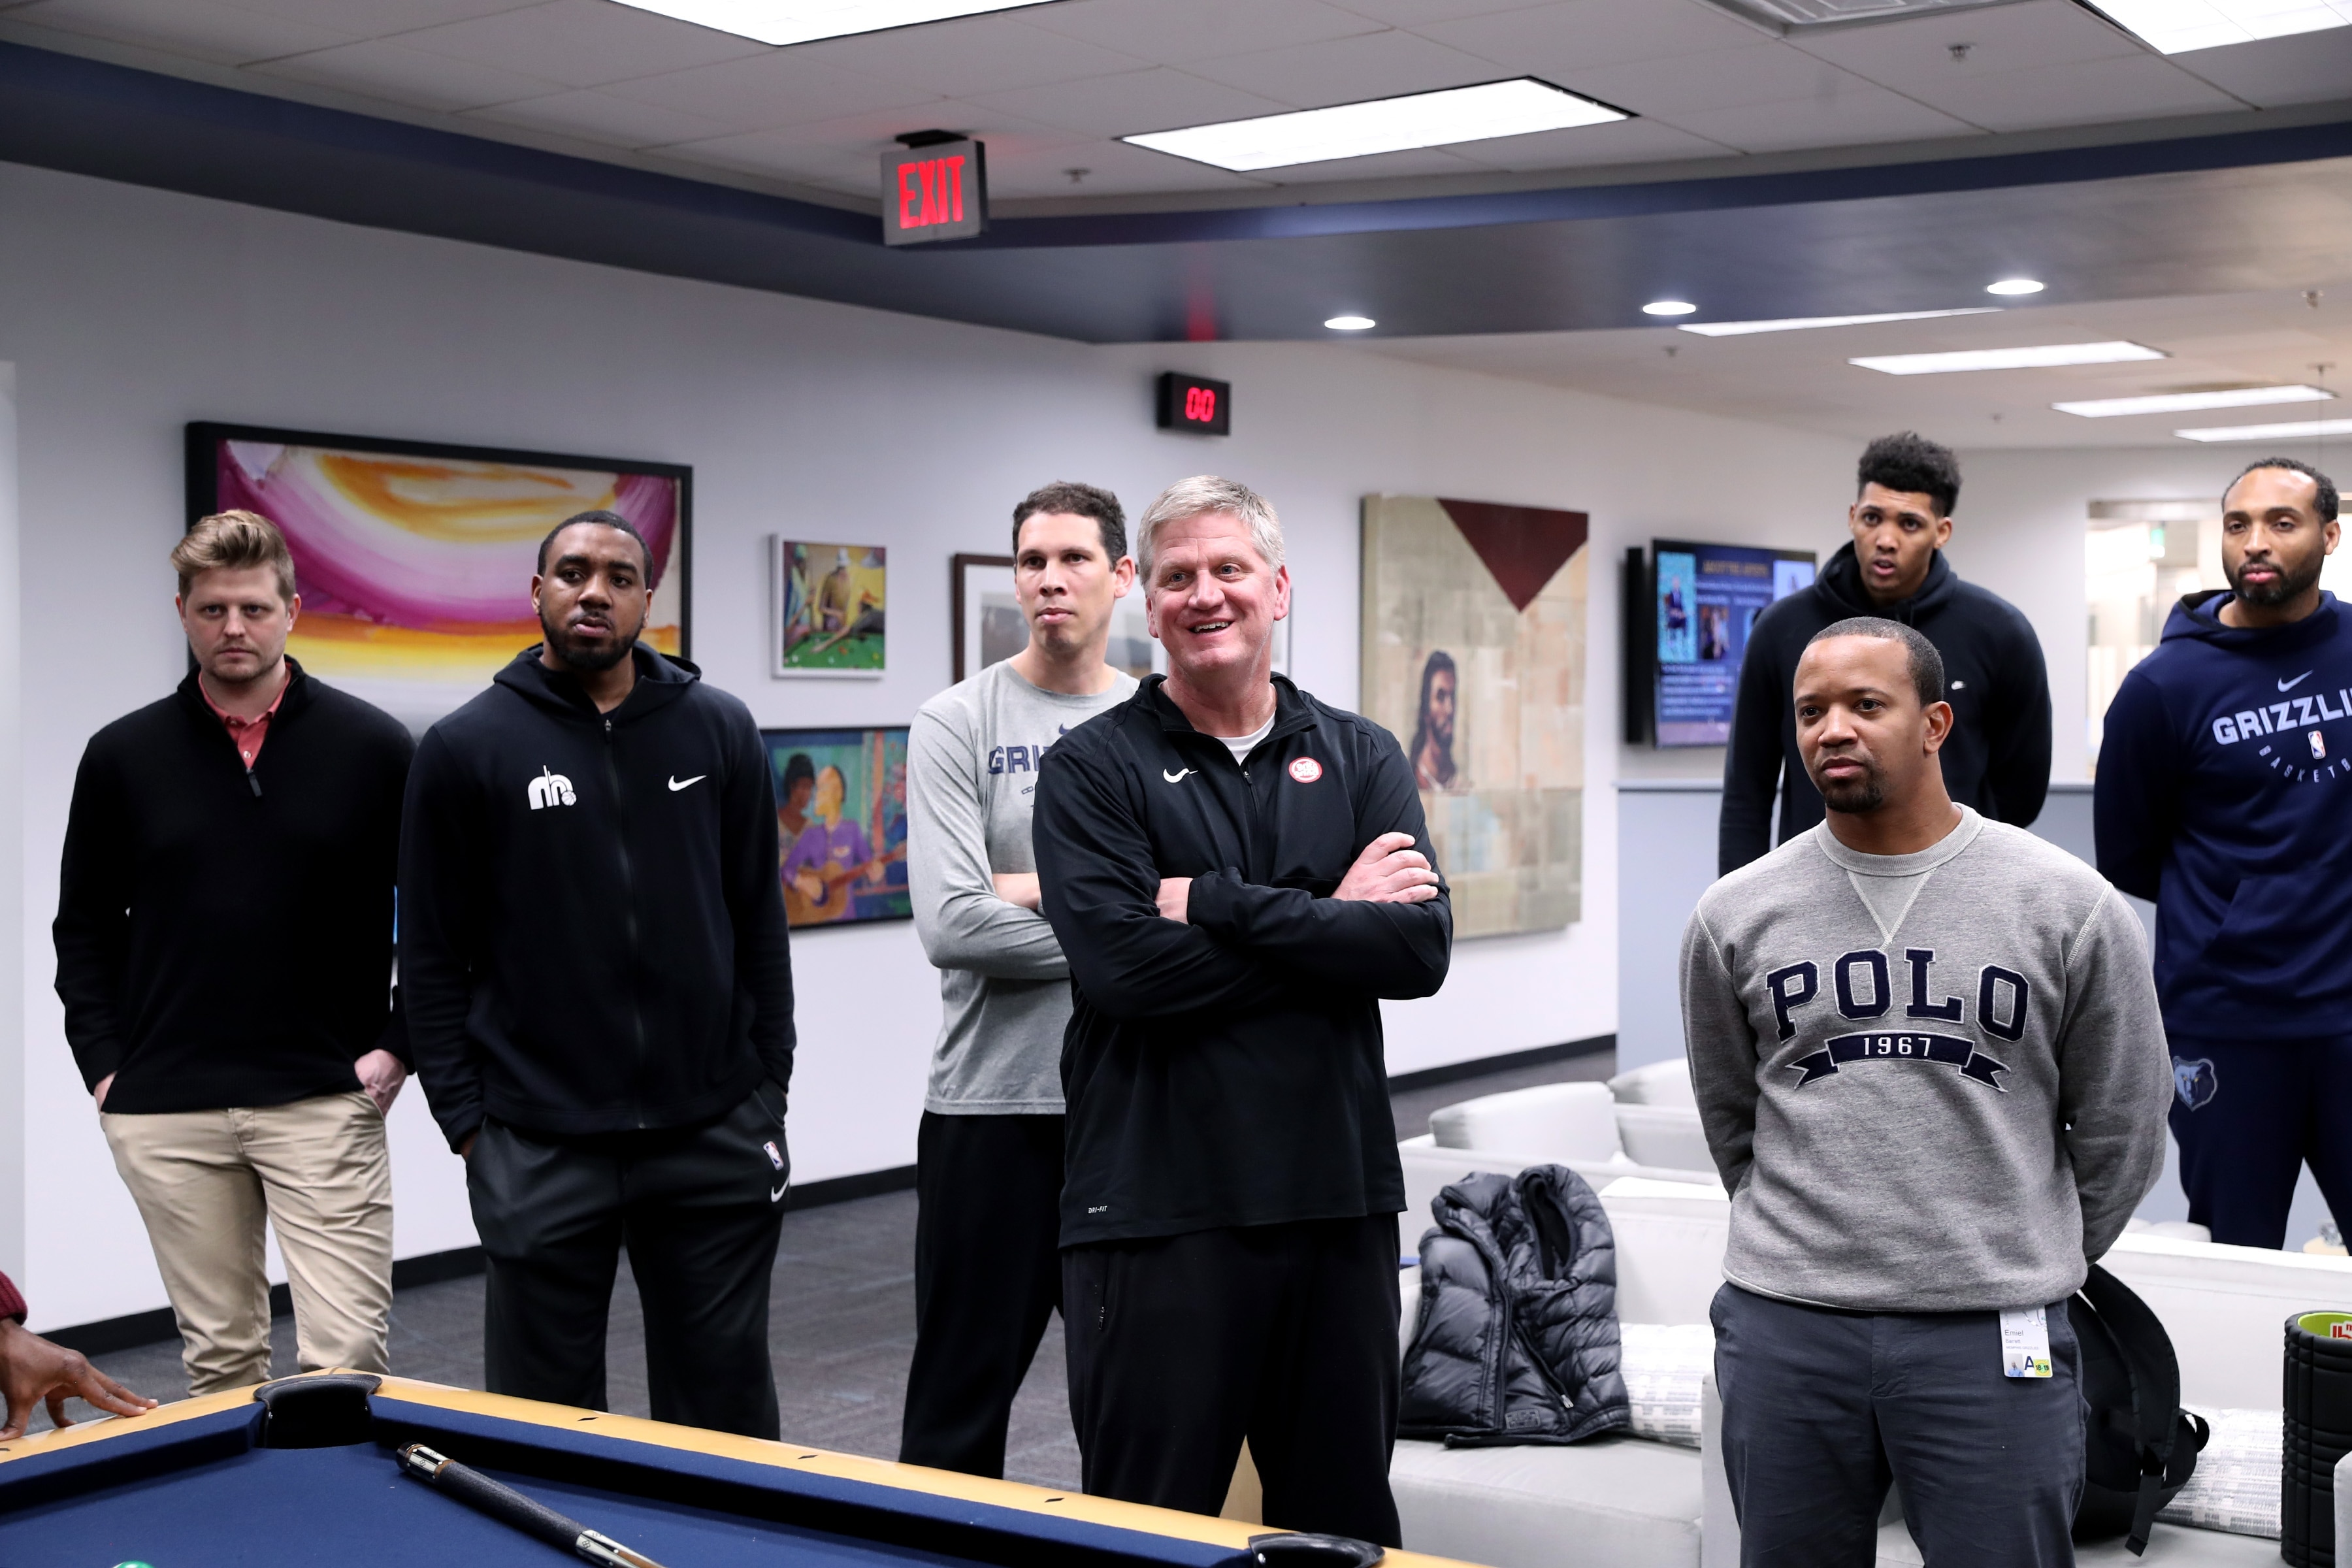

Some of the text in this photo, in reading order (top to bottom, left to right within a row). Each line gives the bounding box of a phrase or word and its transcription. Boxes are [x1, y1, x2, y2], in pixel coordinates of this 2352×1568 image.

[898, 155, 965, 229] EXIT
[1185, 387, 1215, 422] 00
[2212, 688, 2352, 745] GRIZZLI
[988, 744, 1053, 775] GRI
[1765, 947, 2030, 1043] POLO
[1863, 1036, 1931, 1056] 1967
[1088, 1205, 1107, 1214] DRI-FIT
[2024, 1356, 2034, 1371] A
